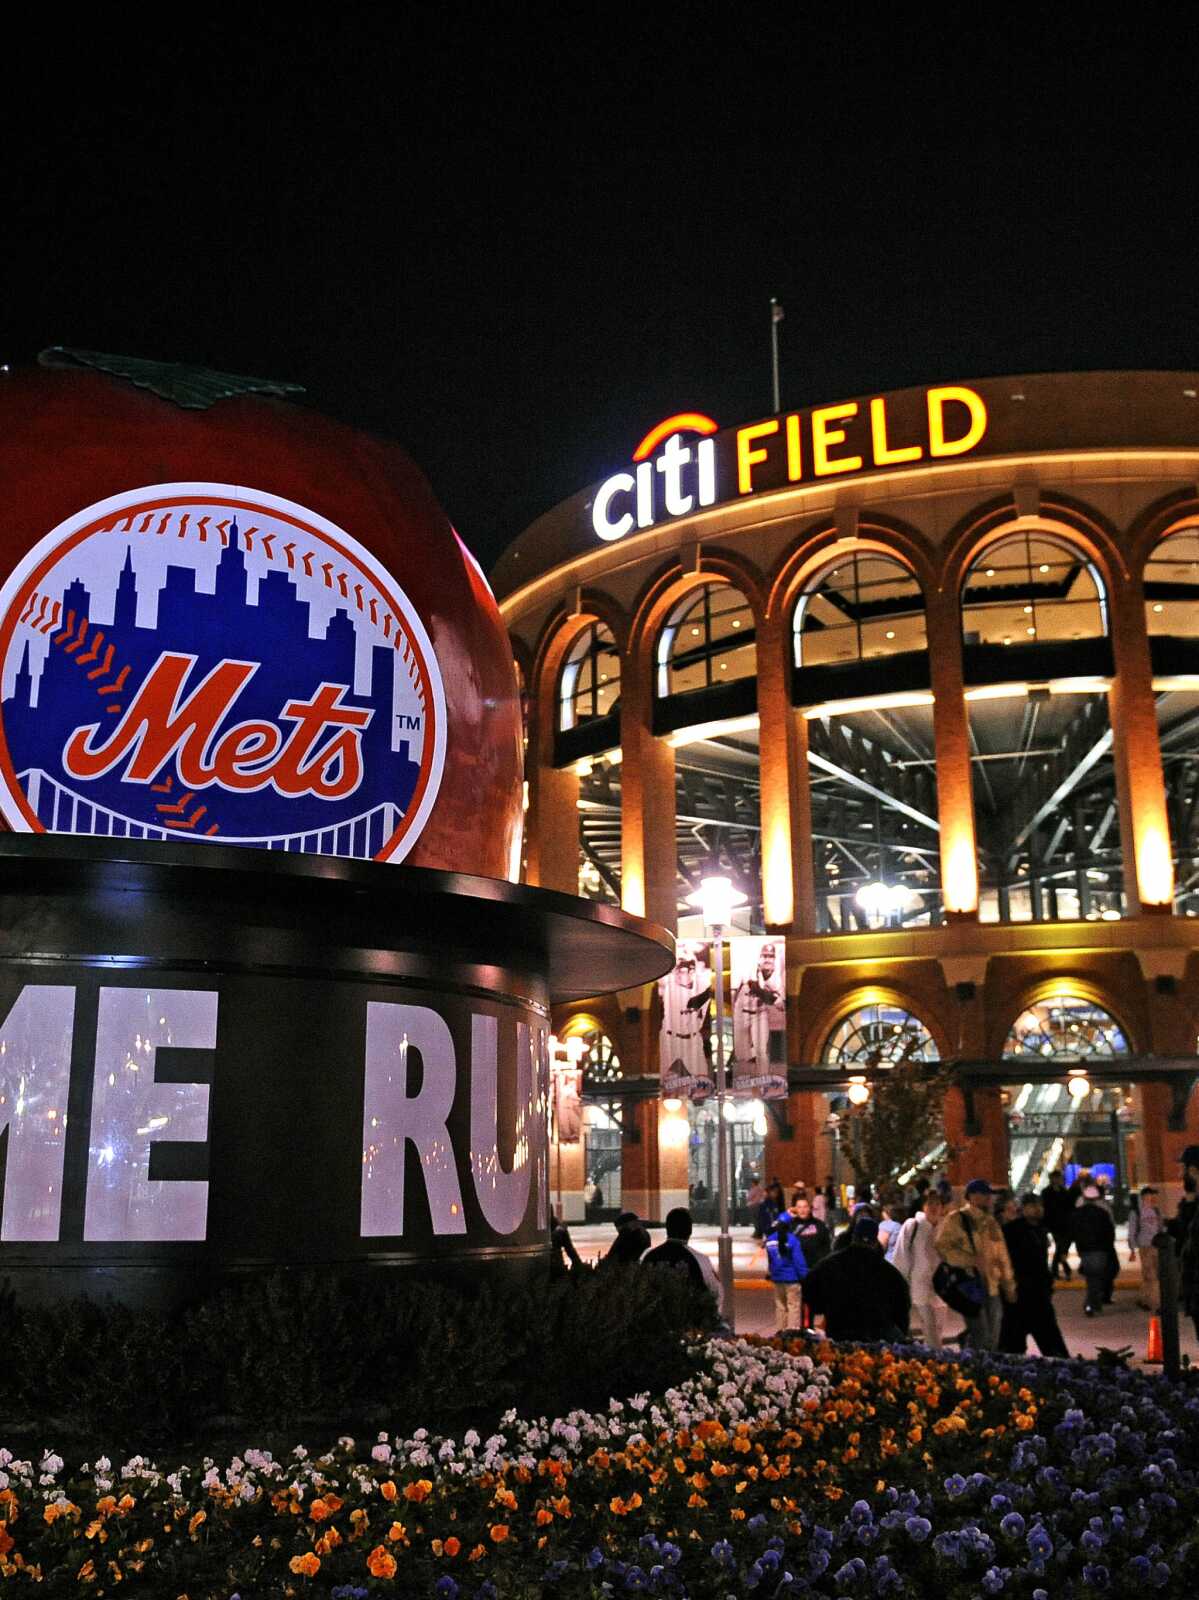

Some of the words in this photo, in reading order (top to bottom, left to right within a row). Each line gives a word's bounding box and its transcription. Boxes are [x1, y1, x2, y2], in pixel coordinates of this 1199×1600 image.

[592, 432, 717, 542] citi
[736, 386, 989, 495] FIELD
[62, 651, 376, 801] Mets
[395, 714, 421, 731] TM
